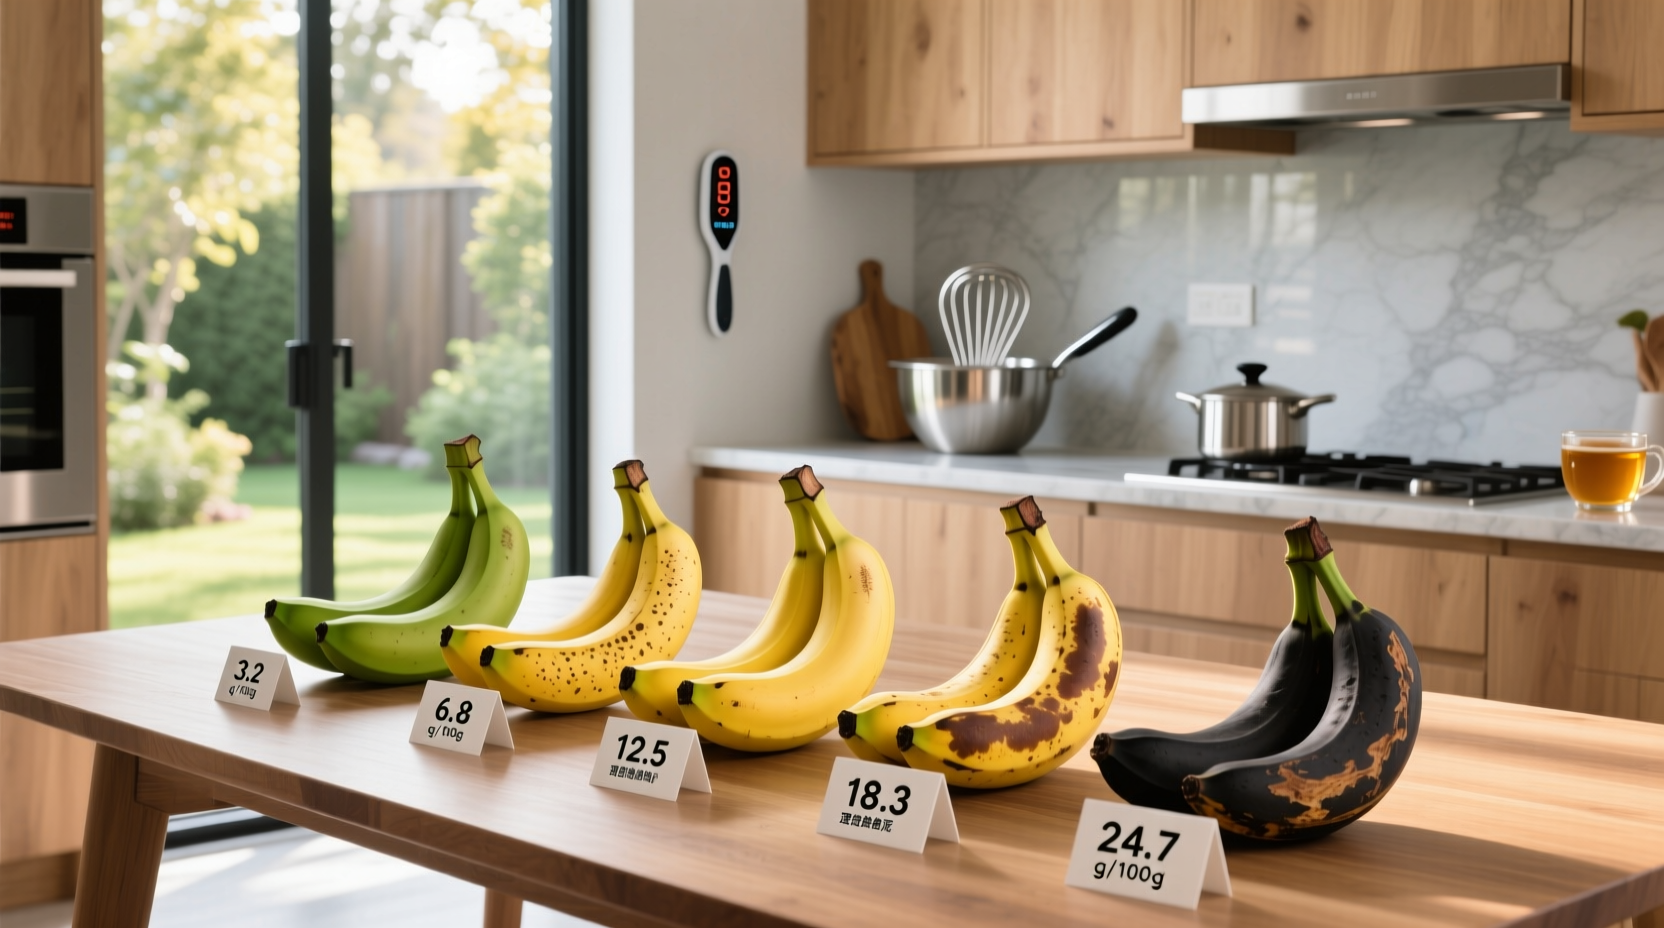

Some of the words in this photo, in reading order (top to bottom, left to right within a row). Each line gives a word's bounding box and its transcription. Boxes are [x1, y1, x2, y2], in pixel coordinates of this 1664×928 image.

[234, 659, 265, 684] 3.2
[435, 697, 473, 725] 6.8
[617, 734, 670, 767] 12.5
[848, 777, 911, 816] 18.3
[1097, 821, 1181, 862] 24.7
[1093, 859, 1165, 891] g/100g
